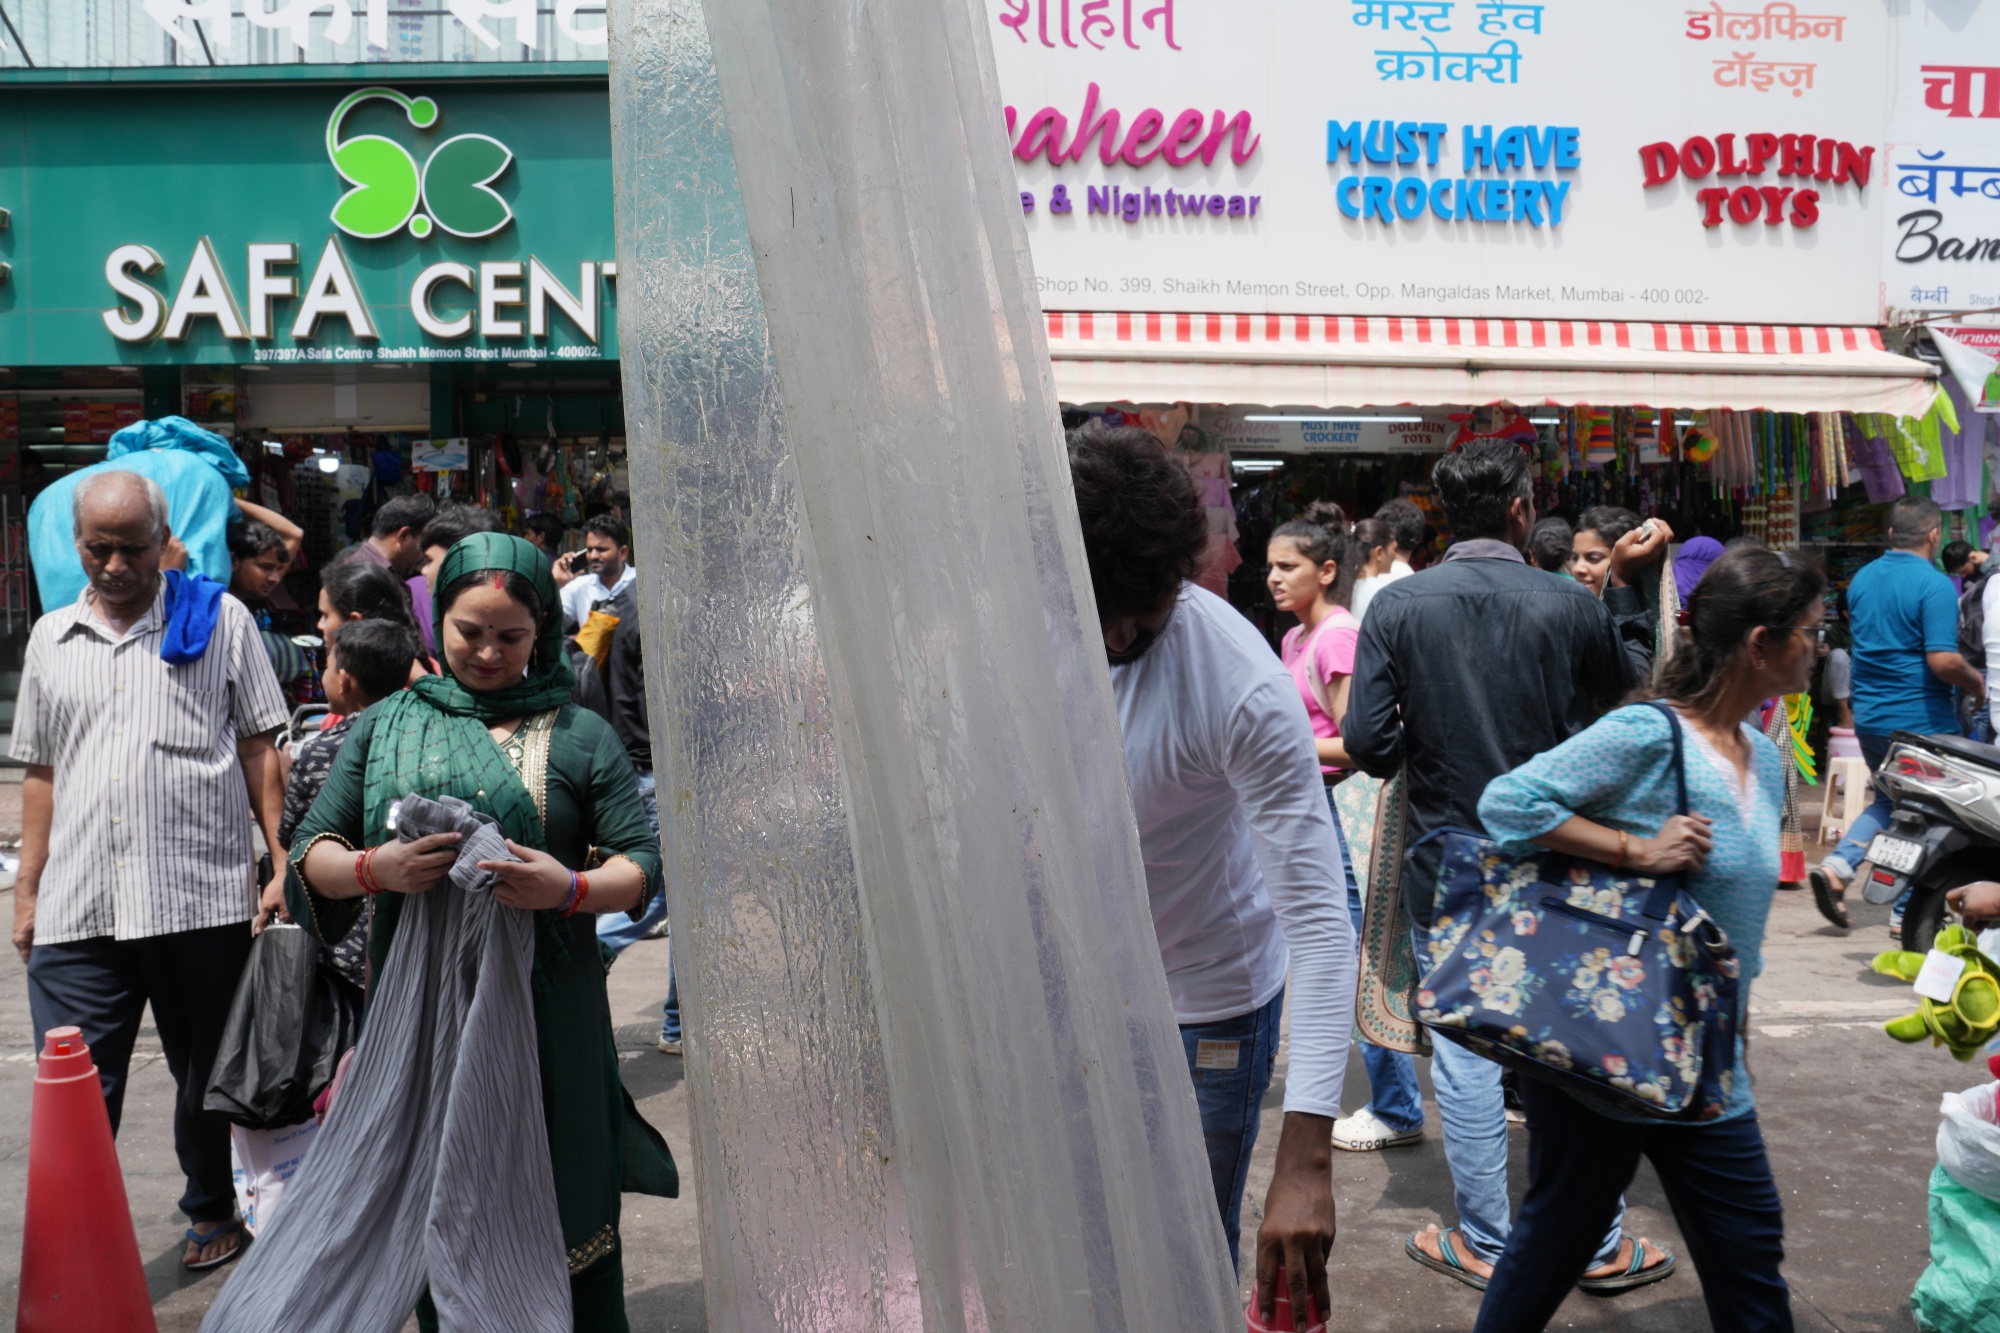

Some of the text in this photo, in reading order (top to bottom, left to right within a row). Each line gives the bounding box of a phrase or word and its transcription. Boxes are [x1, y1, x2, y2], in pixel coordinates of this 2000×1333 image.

[1684, 1, 1847, 42] डोलफिन
[1004, 82, 1262, 166] aheen
[1325, 119, 1582, 173] MUST HAVE
[1638, 132, 1876, 188] DOLPHIN
[1049, 184, 1072, 214] &
[1087, 185, 1262, 222] Nightwear
[1335, 175, 1572, 228] CROCKERY
[1696, 185, 1820, 229] TOYS
[103, 234, 378, 342] SAFA
[410, 255, 617, 342] CEN
[1084, 277, 1112, 293] No.
[1120, 278, 1156, 295] 399,
[1162, 278, 1221, 294] Shaikh
[1226, 280, 1289, 295] Memon
[1295, 281, 1350, 298] Street,
[1355, 282, 1395, 299] Opp.
[1401, 283, 1490, 303] Mangaldas
[1496, 285, 1555, 302] Market,
[1561, 286, 1625, 302] Mumbai
[1640, 288, 1669, 304] 400
[1969, 294, 1995, 307] Shop
[307, 347, 333, 360] Safa
[335, 348, 373, 360] Centre
[377, 347, 417, 359] Shaikh
[420, 347, 462, 360] Memon
[464, 347, 499, 360] Street
[502, 347, 547, 359] Mumbai
[1301, 421, 1361, 430] MUST HAVE
[1303, 432, 1359, 443] CROCKERY
[1388, 421, 1446, 434] DOLPHIN
[1402, 434, 1432, 444] TOYS
[1350, 1138, 1388, 1149] crocs
